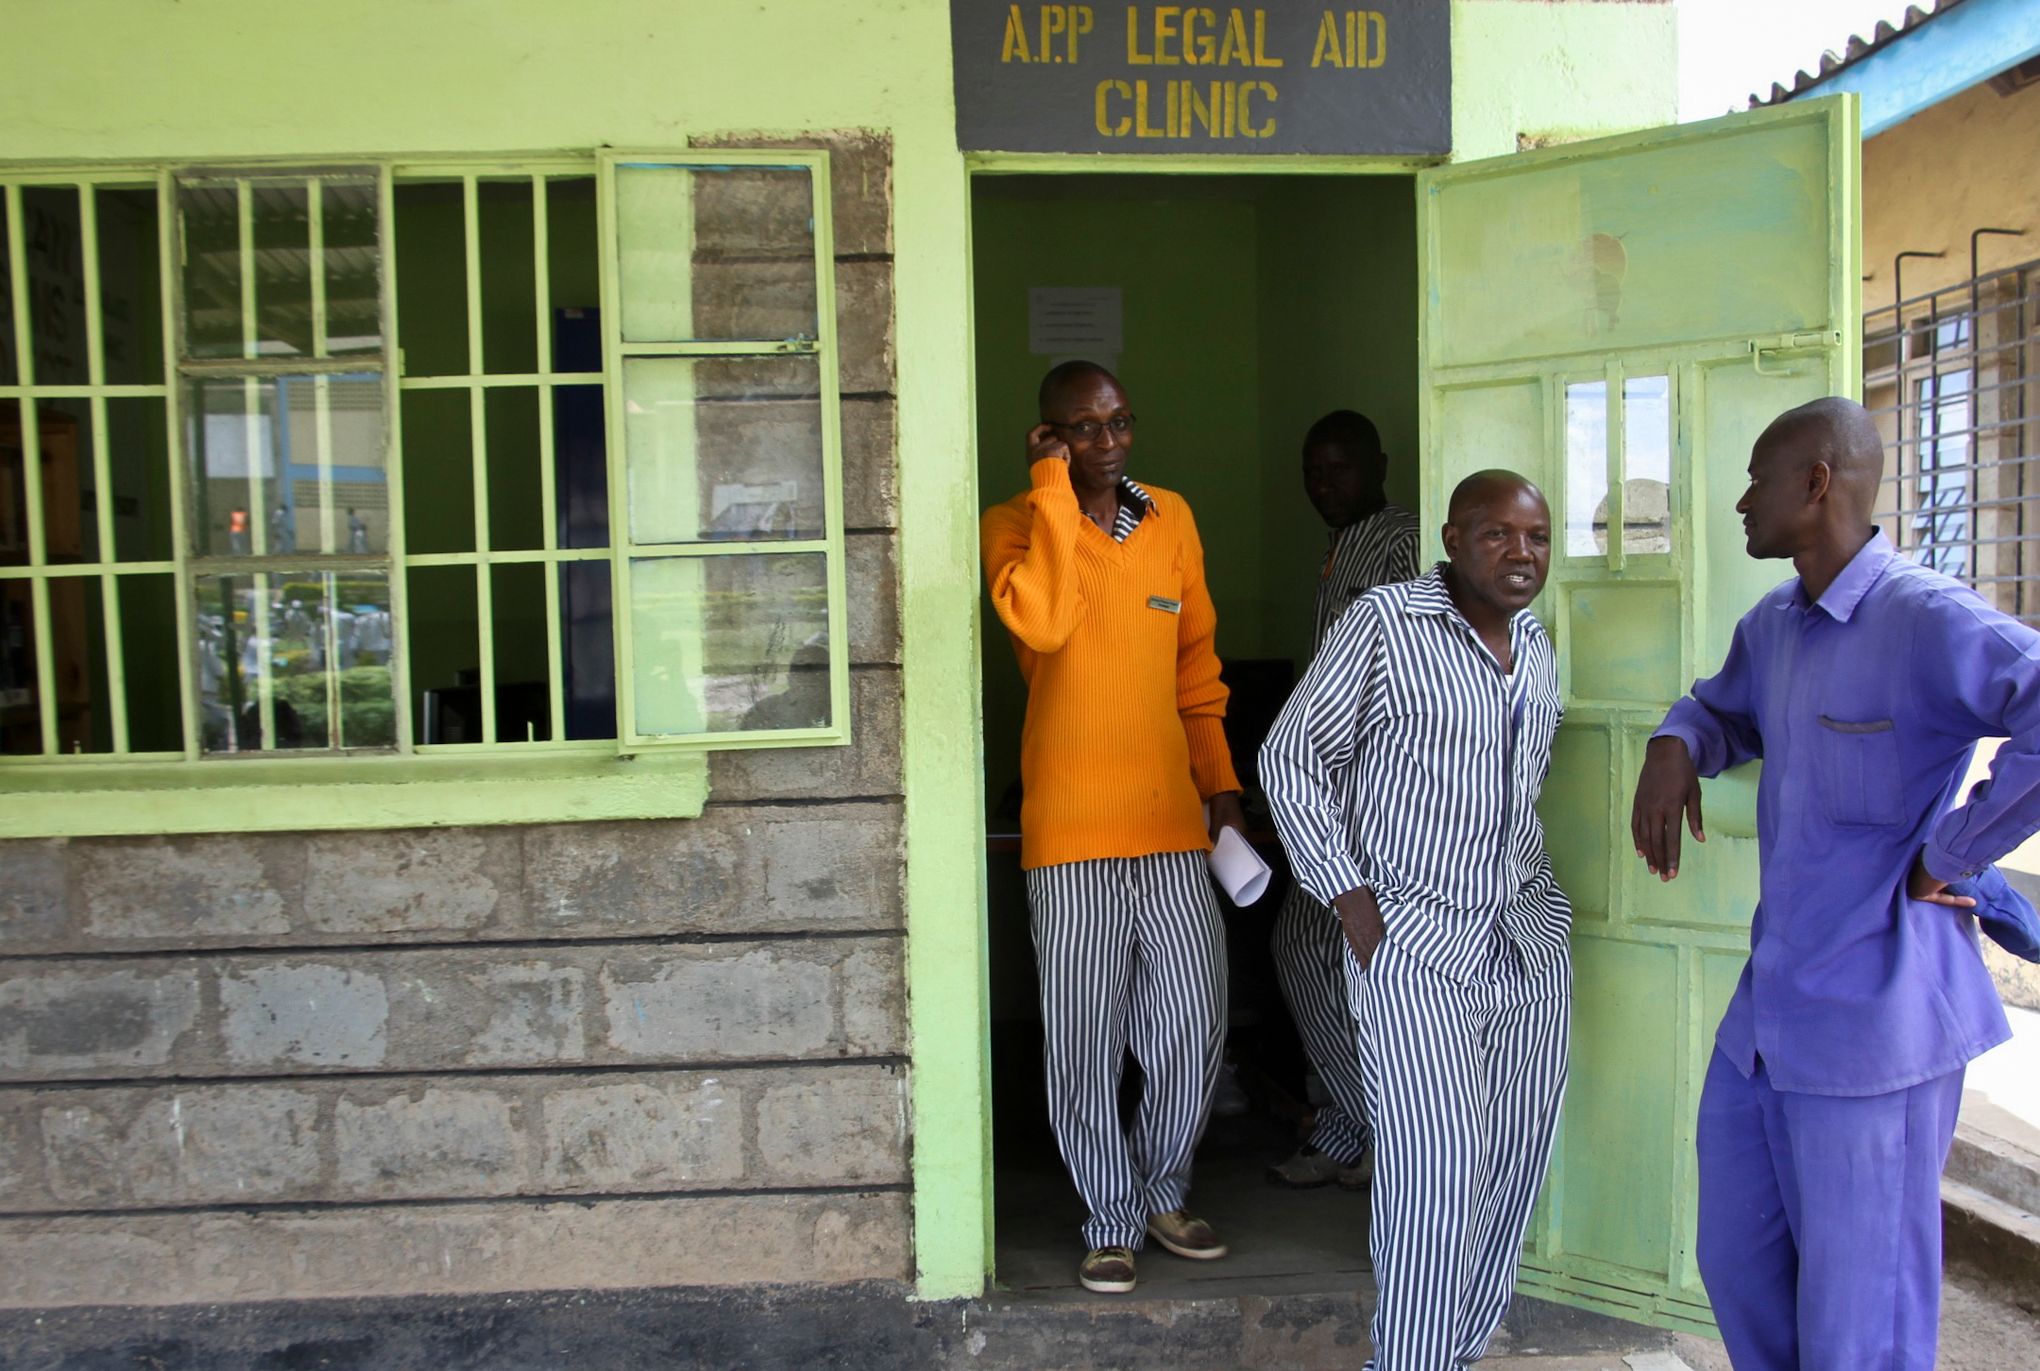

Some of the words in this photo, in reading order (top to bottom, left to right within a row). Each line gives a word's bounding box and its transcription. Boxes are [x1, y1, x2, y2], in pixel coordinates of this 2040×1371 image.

[1127, 5, 1283, 68] LEGAL
[1311, 9, 1387, 69] AID
[1094, 79, 1278, 139] CLINIC
